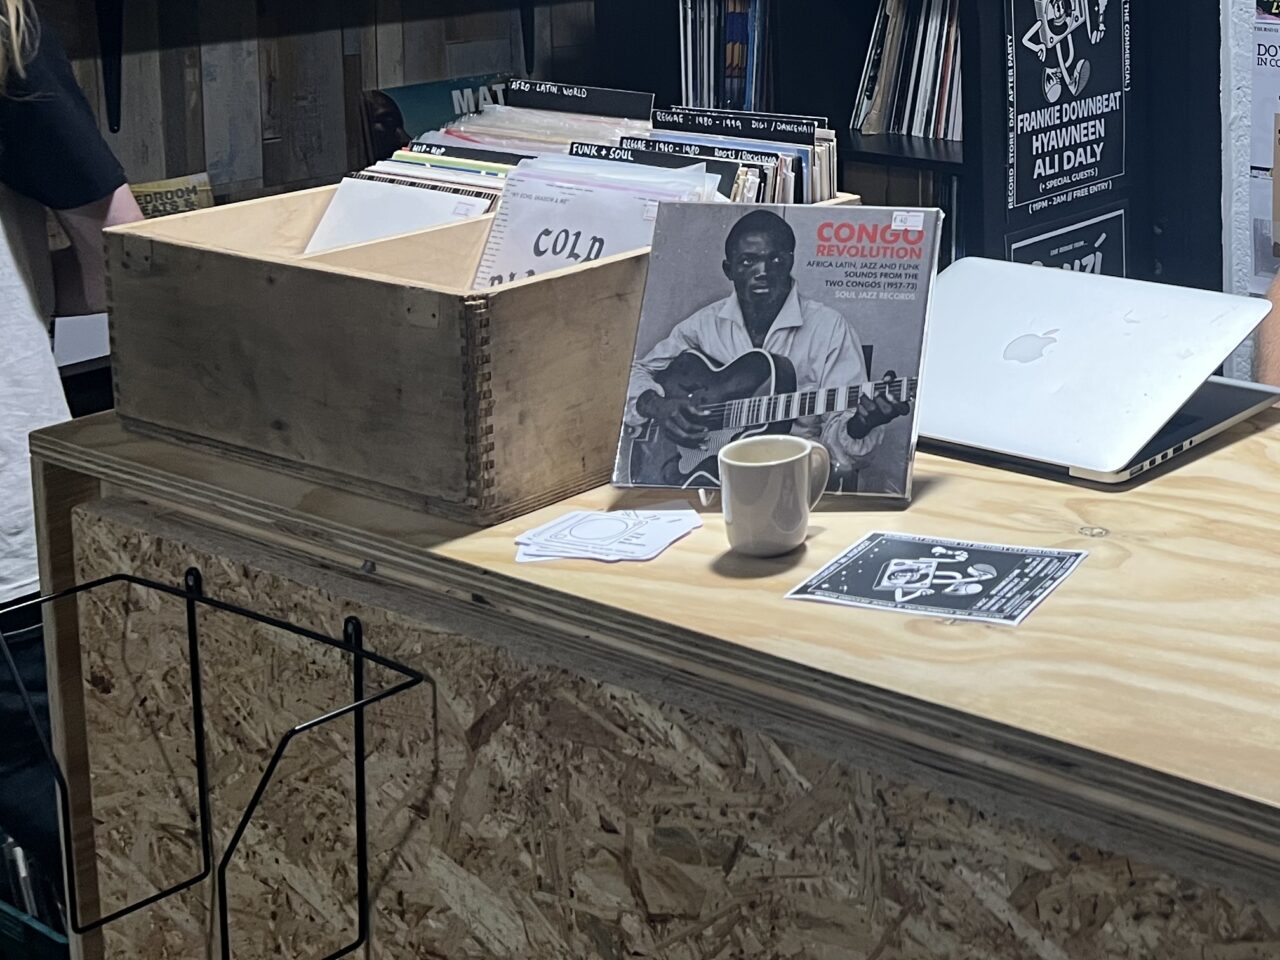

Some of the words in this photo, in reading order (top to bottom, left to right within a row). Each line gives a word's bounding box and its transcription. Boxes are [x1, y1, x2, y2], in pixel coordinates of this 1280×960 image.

[1257, 57, 1267, 66] IN
[510, 81, 531, 92] AFRO
[562, 87, 587, 99] WORLD
[656, 111, 684, 124] REGGAE
[695, 114, 712, 126] 1980
[1017, 104, 1061, 135] FRANKIE
[1062, 91, 1122, 118] DOWNBEAT
[622, 139, 646, 151] REGGAE
[1032, 118, 1106, 156] HYAWNEEN
[572, 143, 599, 158] FUNK
[609, 148, 634, 162] SOUL
[1033, 153, 1059, 179] ALI
[1062, 142, 1105, 172] DALY
[1046, 172, 1071, 189] SPECIAL
[1072, 169, 1094, 183] GUESTS
[1052, 193, 1067, 205] 2AM
[1073, 188, 1089, 199] FREE
[1089, 181, 1109, 196] ENTRY
[817, 221, 925, 246] CONGO
[533, 228, 605, 263] COLD
[816, 244, 922, 260] REVOLUTION
[835, 262, 857, 270] LATIN,
[860, 262, 877, 270] JAZZ
[844, 271, 878, 279] SOUNDS
[845, 280, 881, 289] CONGOS
[883, 281, 917, 290] (1957-73)
[834, 291, 856, 299] SOUL
[879, 292, 916, 301] RECORDS
